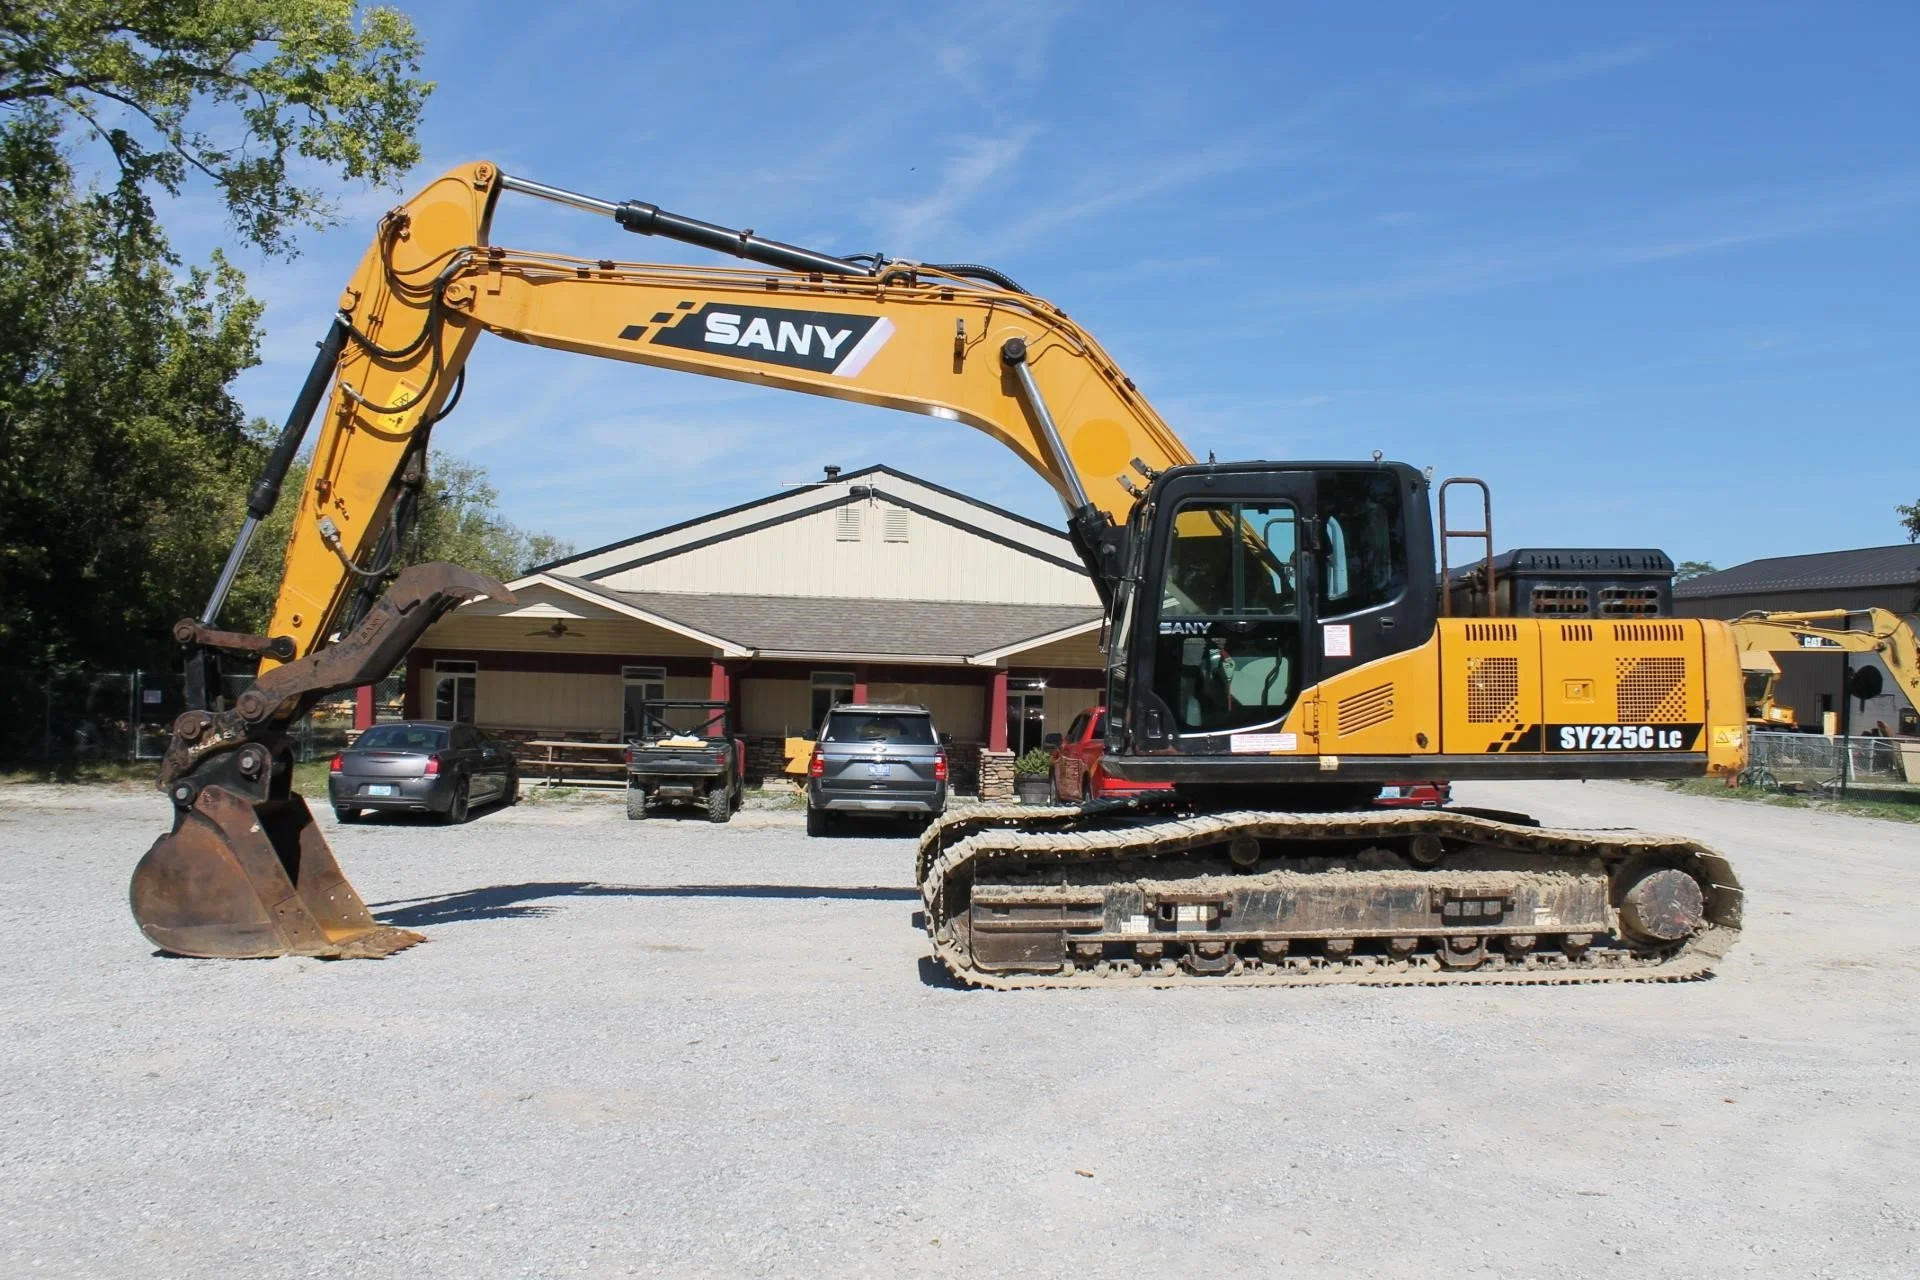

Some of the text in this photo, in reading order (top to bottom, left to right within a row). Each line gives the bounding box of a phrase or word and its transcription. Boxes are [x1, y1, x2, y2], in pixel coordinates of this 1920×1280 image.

[704, 312, 852, 359] SANY
[1159, 622, 1212, 634] SANY
[1804, 636, 1823, 648] CAT
[1560, 726, 1682, 749] SY225C LC
